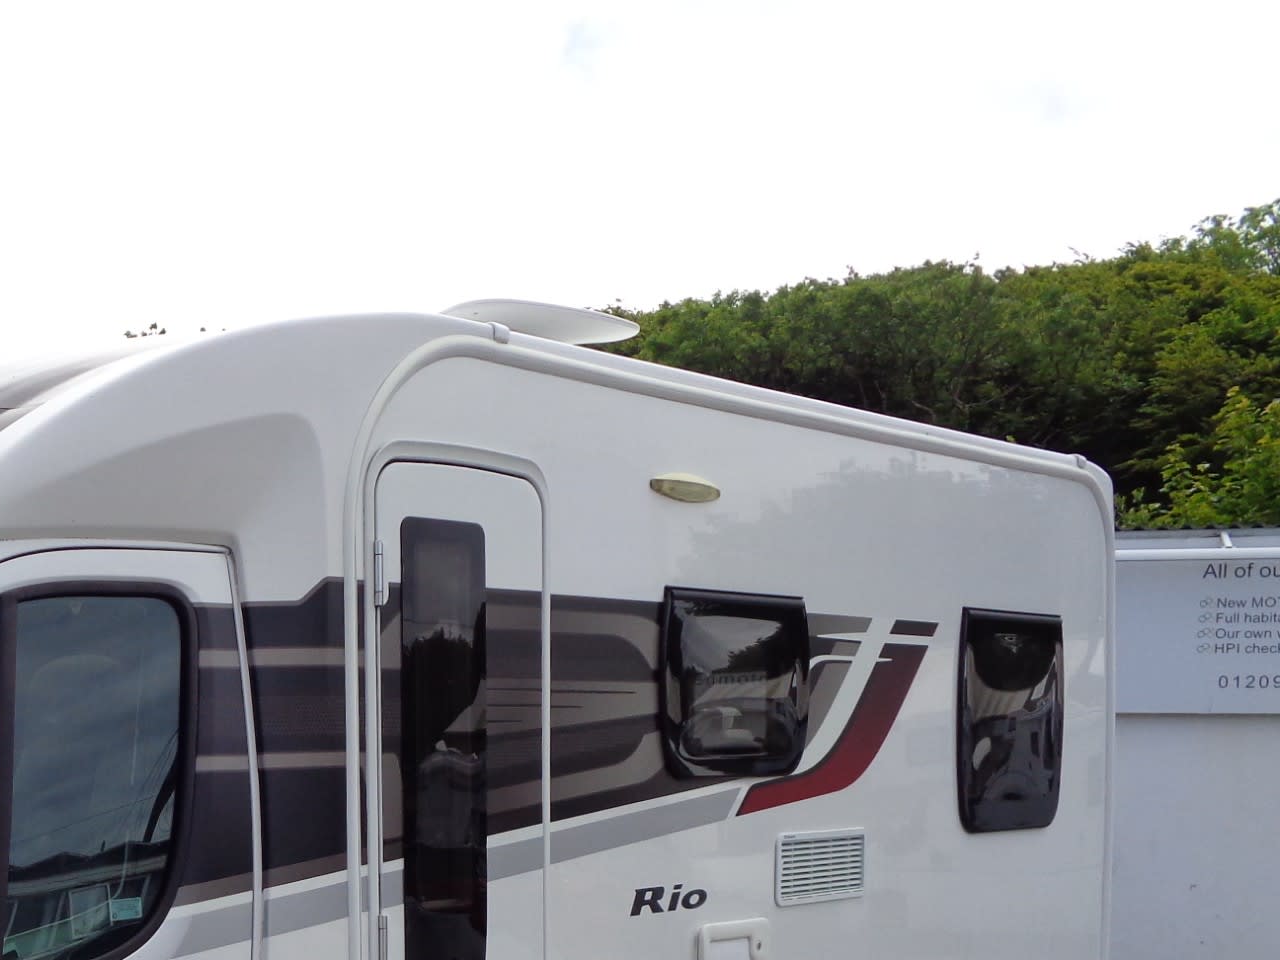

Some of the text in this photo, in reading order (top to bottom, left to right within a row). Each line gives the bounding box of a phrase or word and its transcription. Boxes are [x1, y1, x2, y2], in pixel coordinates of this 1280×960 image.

[1202, 563, 1227, 579] All
[1234, 562, 1255, 578] of
[1216, 596, 1280, 609] New MO
[1215, 612, 1240, 624] Full
[1215, 628, 1240, 639] Our
[1244, 630, 1272, 639] own
[1215, 643, 1240, 654] HPI
[630, 884, 708, 917] Rio
